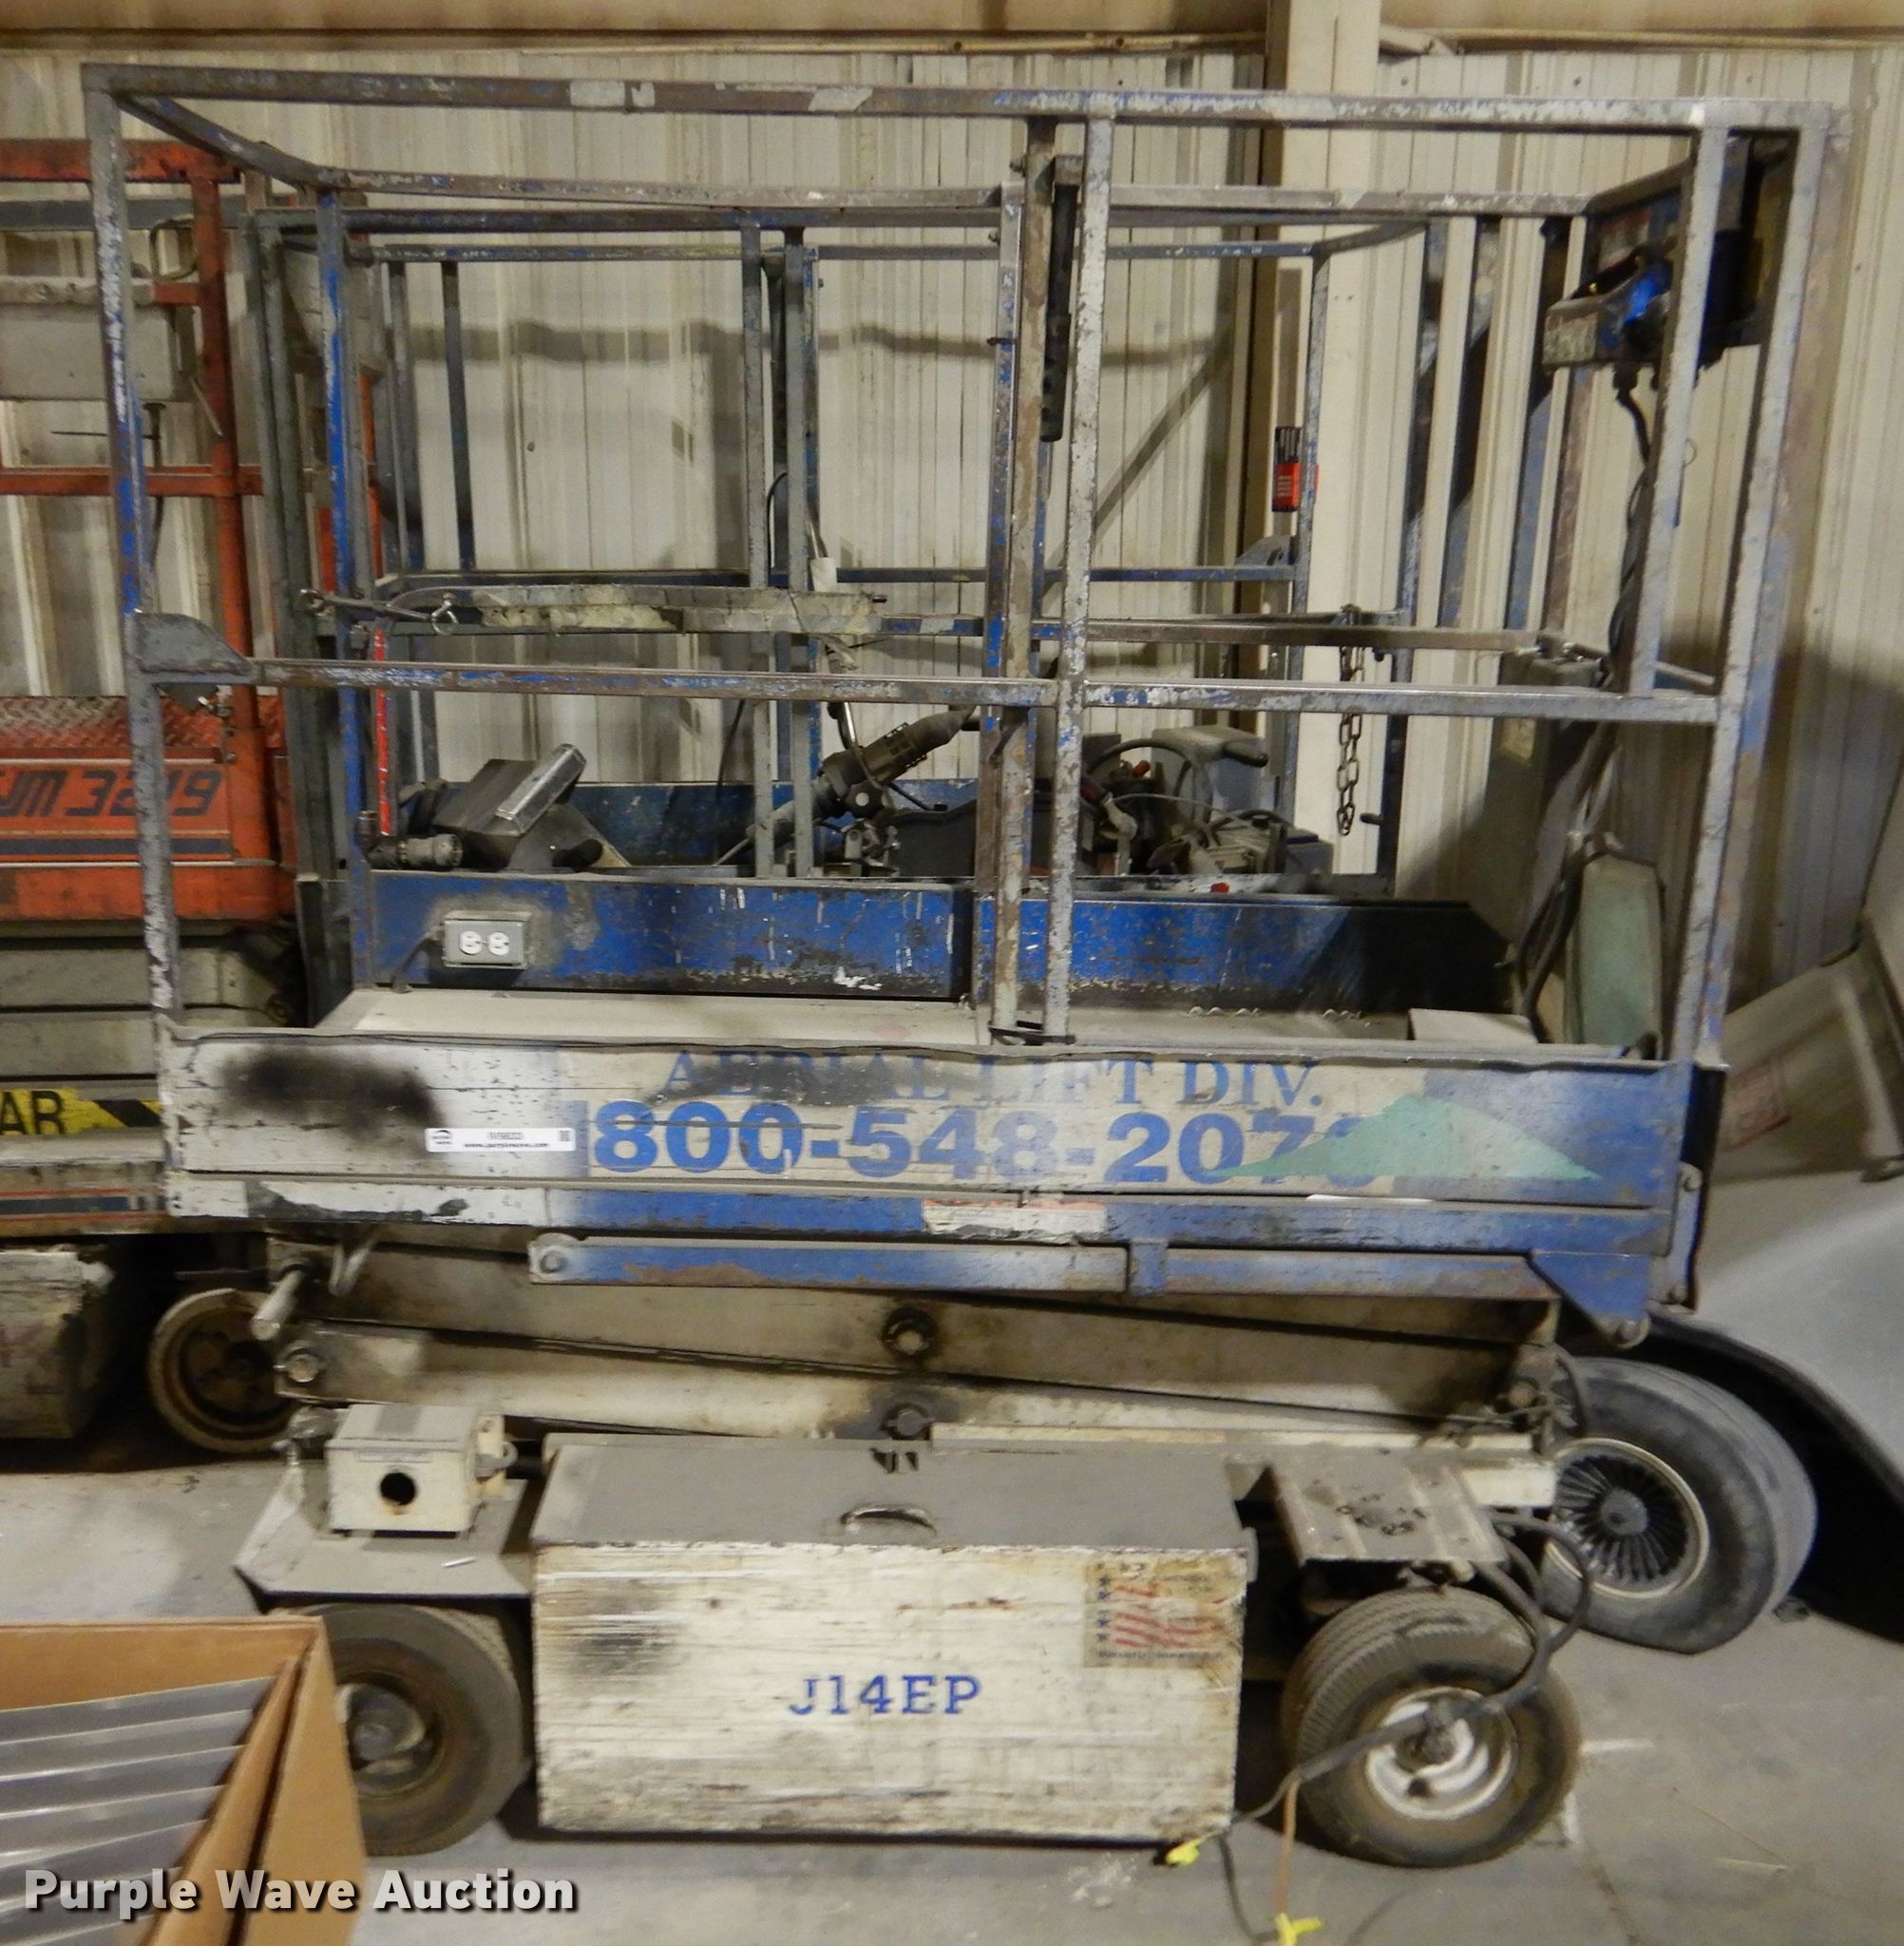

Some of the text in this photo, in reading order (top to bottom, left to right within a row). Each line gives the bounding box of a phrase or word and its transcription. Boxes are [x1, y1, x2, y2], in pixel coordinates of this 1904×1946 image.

[974, 1055, 1153, 1105] LIFT
[1176, 1059, 1323, 1107] DIV.
[789, 1674, 981, 1715] J14EP
